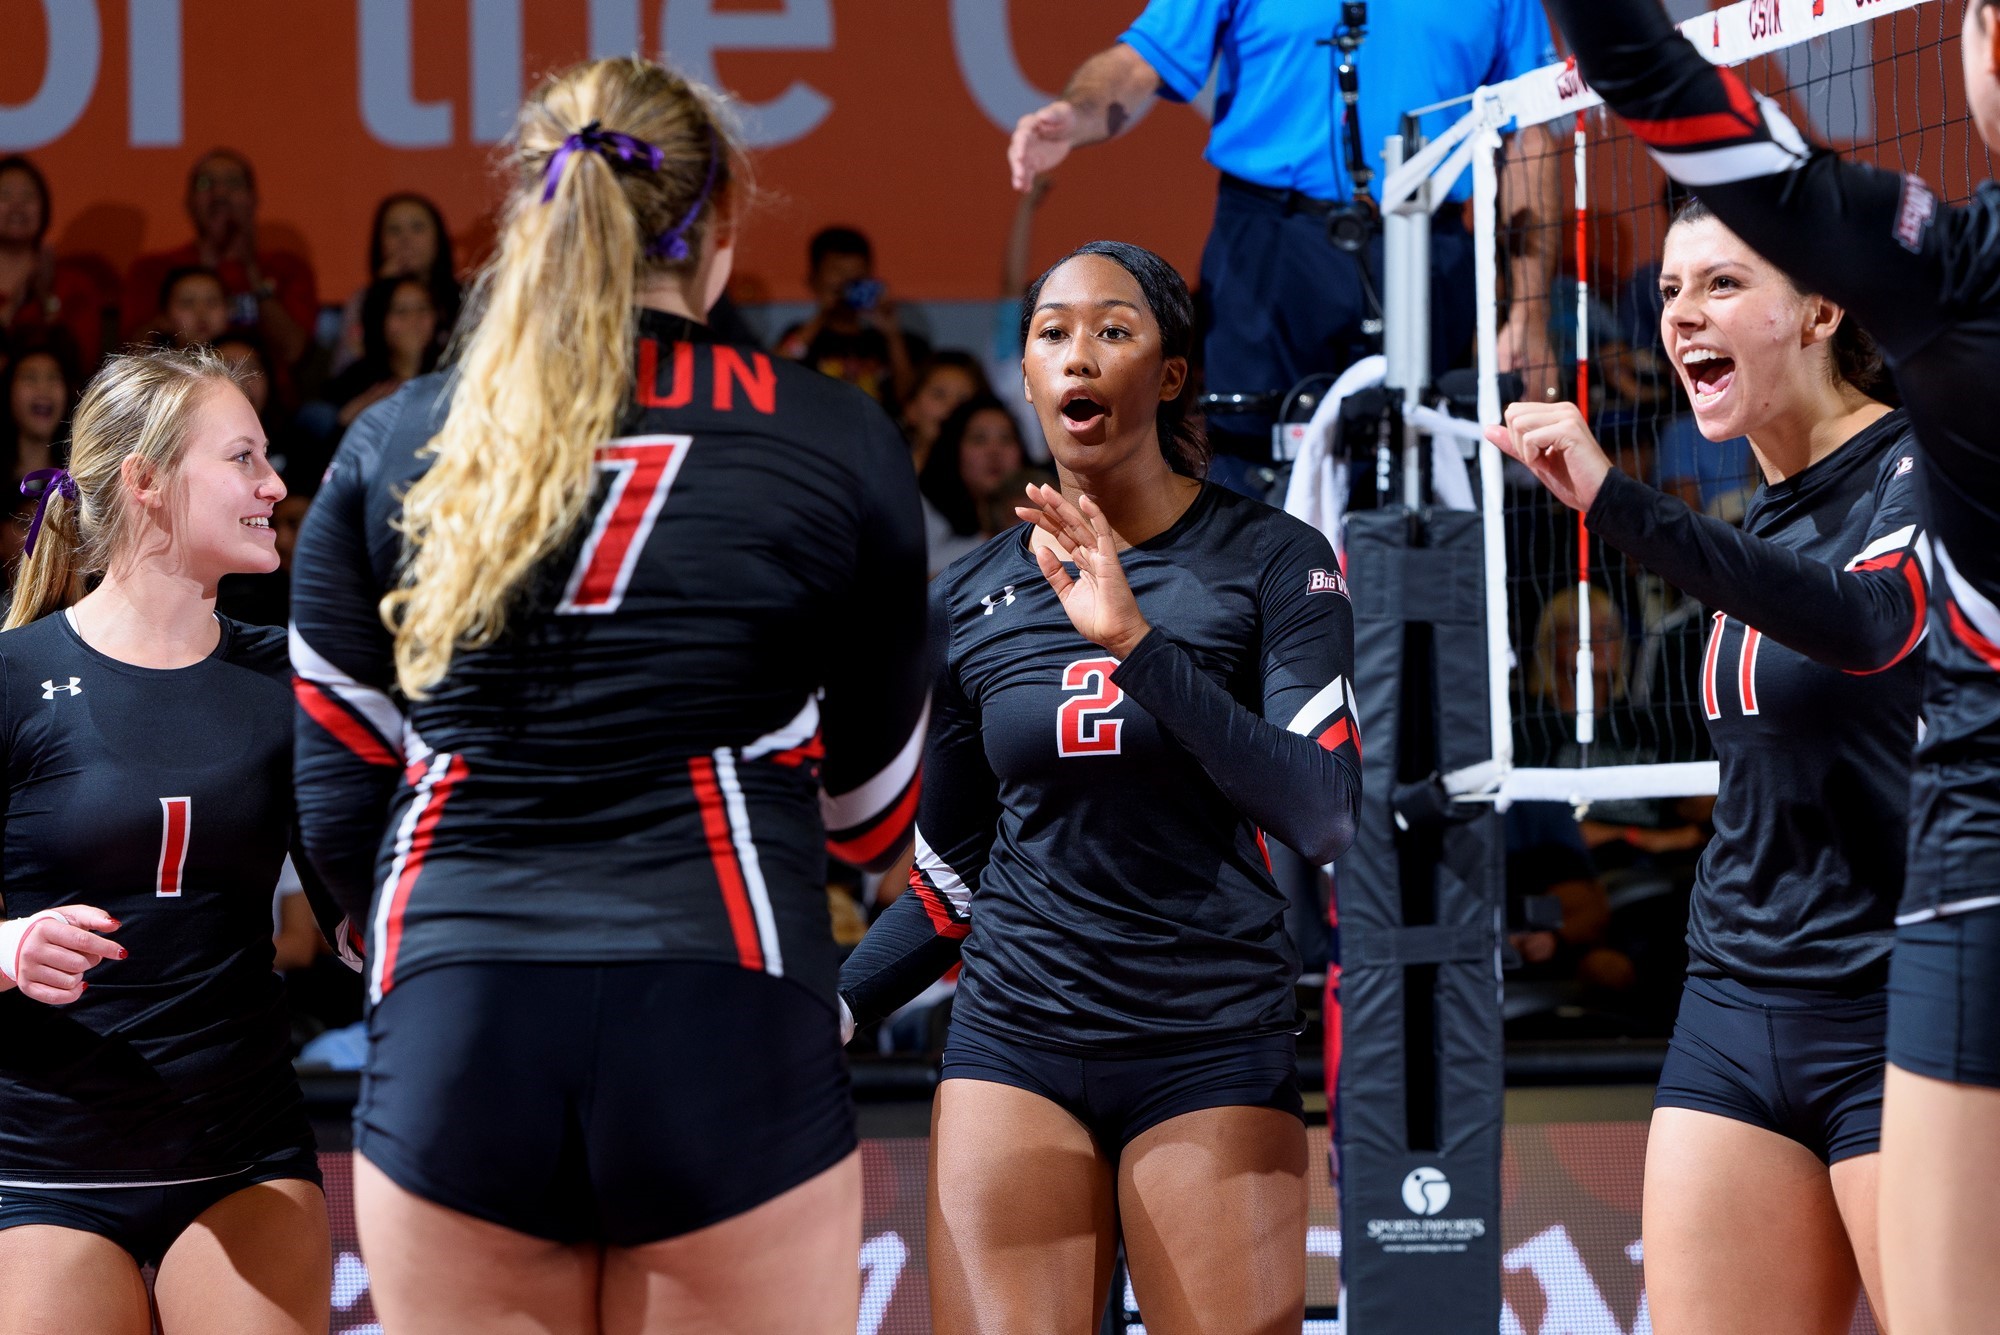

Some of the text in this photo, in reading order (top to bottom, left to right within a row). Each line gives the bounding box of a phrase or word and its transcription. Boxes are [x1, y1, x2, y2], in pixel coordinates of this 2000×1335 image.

[637, 338, 778, 415] UN
[554, 434, 694, 616] 7
[1056, 656, 1124, 758] 2
[1702, 610, 1762, 720] 11
[156, 796, 191, 898] 1
